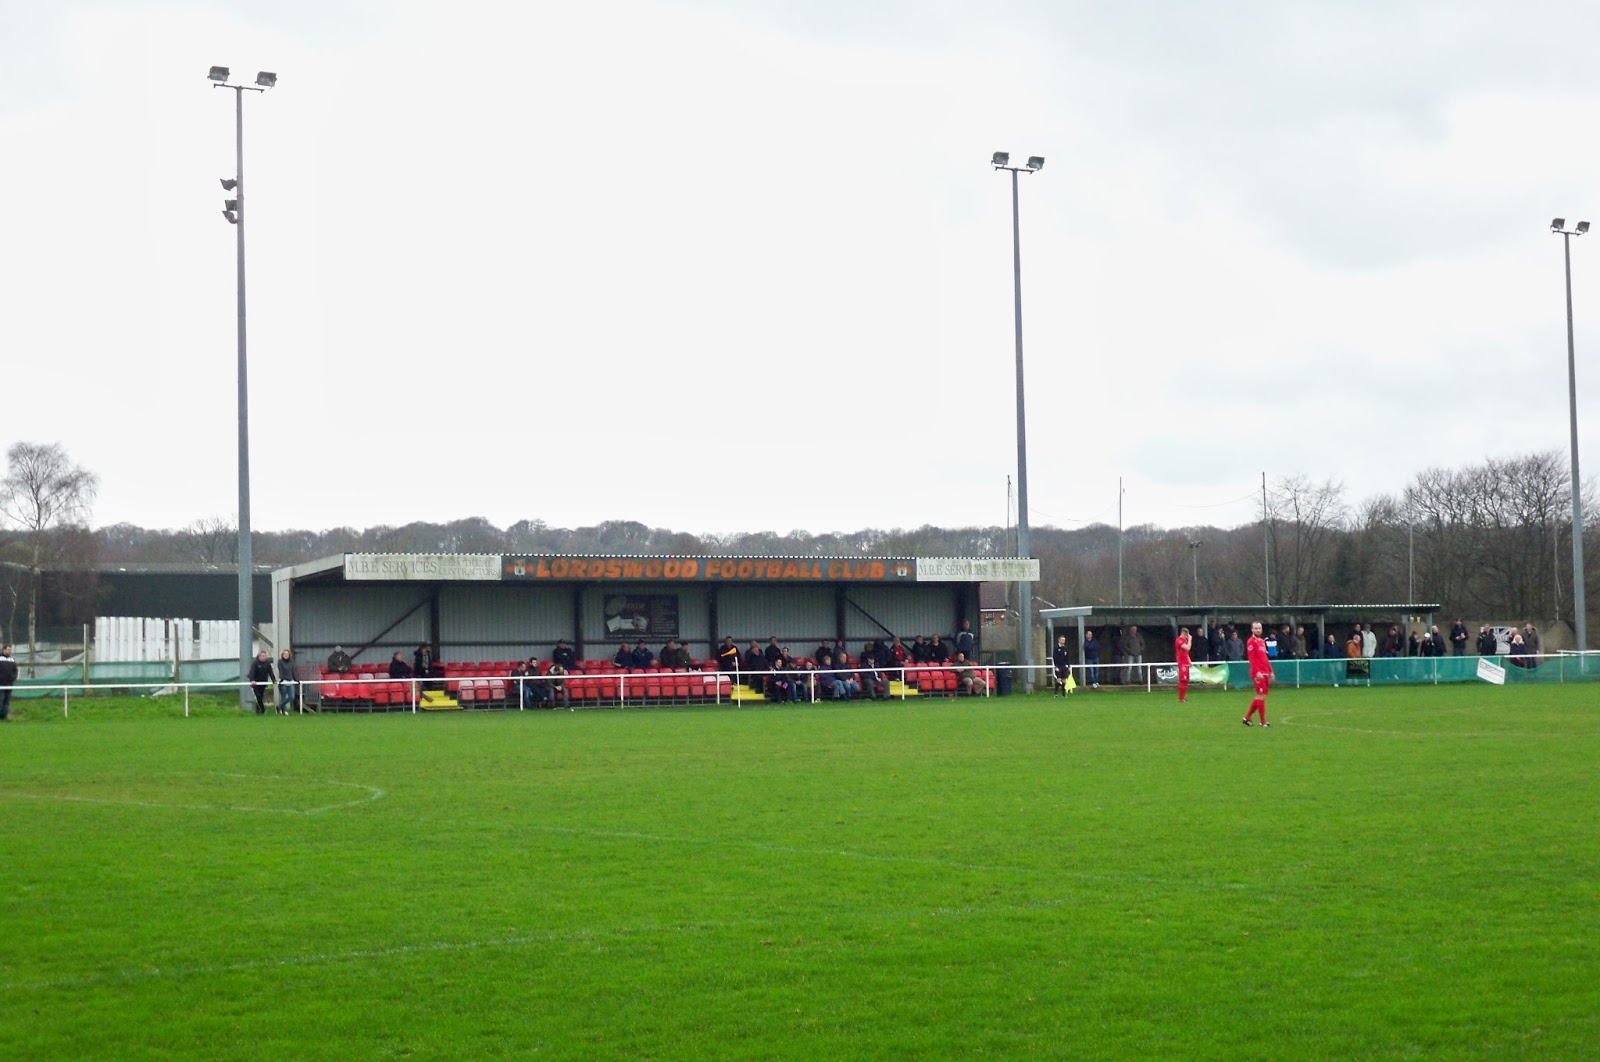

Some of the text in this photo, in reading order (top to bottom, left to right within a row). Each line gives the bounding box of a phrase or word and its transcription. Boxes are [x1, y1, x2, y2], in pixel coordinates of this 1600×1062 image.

[381, 559, 437, 573] SERVICES
[536, 559, 887, 579] LORDSWOOD FOOTBALL CLUB
[944, 563, 988, 576] SERVICES
